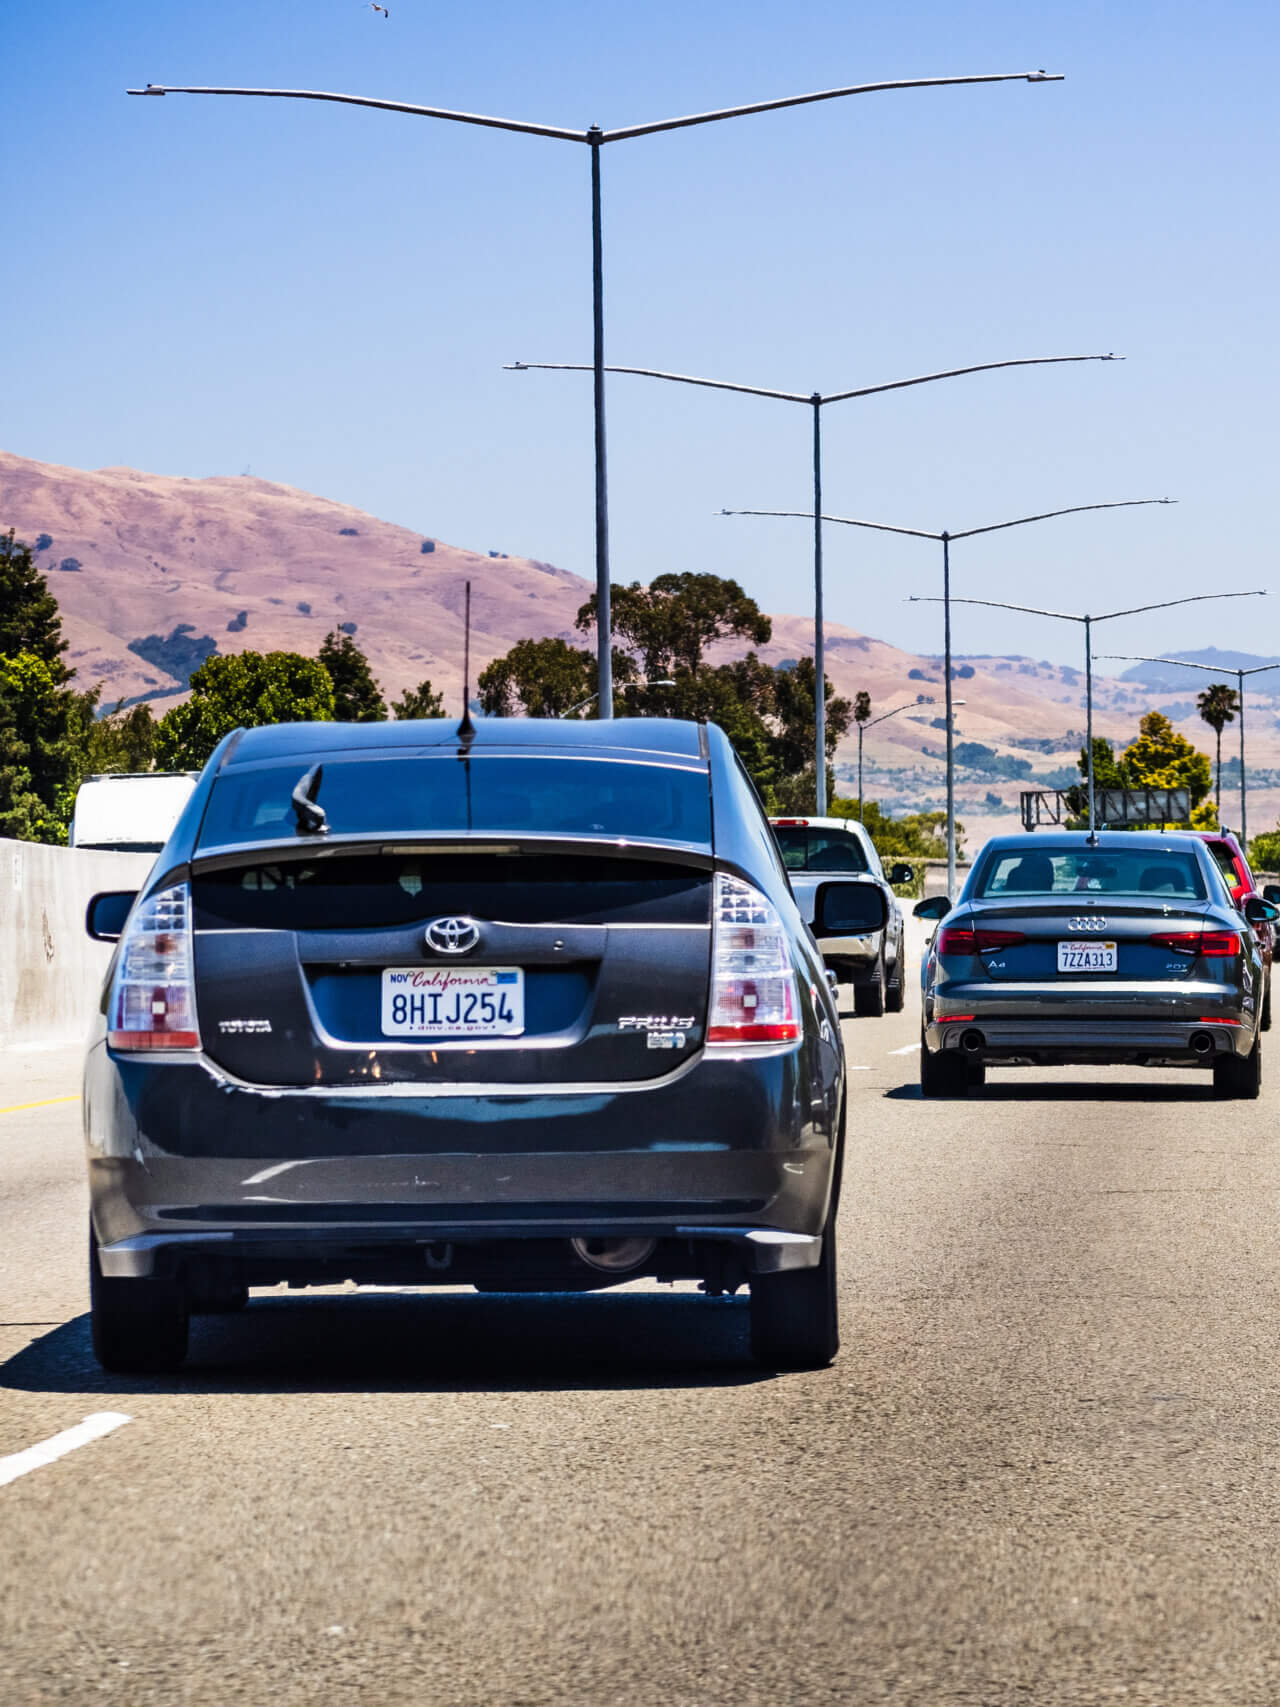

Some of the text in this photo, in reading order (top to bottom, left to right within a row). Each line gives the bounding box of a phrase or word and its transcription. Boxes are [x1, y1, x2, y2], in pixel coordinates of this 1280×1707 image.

[1062, 952, 1113, 967] 7ZZA313
[390, 971, 489, 991] NOV California
[392, 992, 514, 1024] 8HIJ254
[618, 1016, 695, 1030] PRIUS
